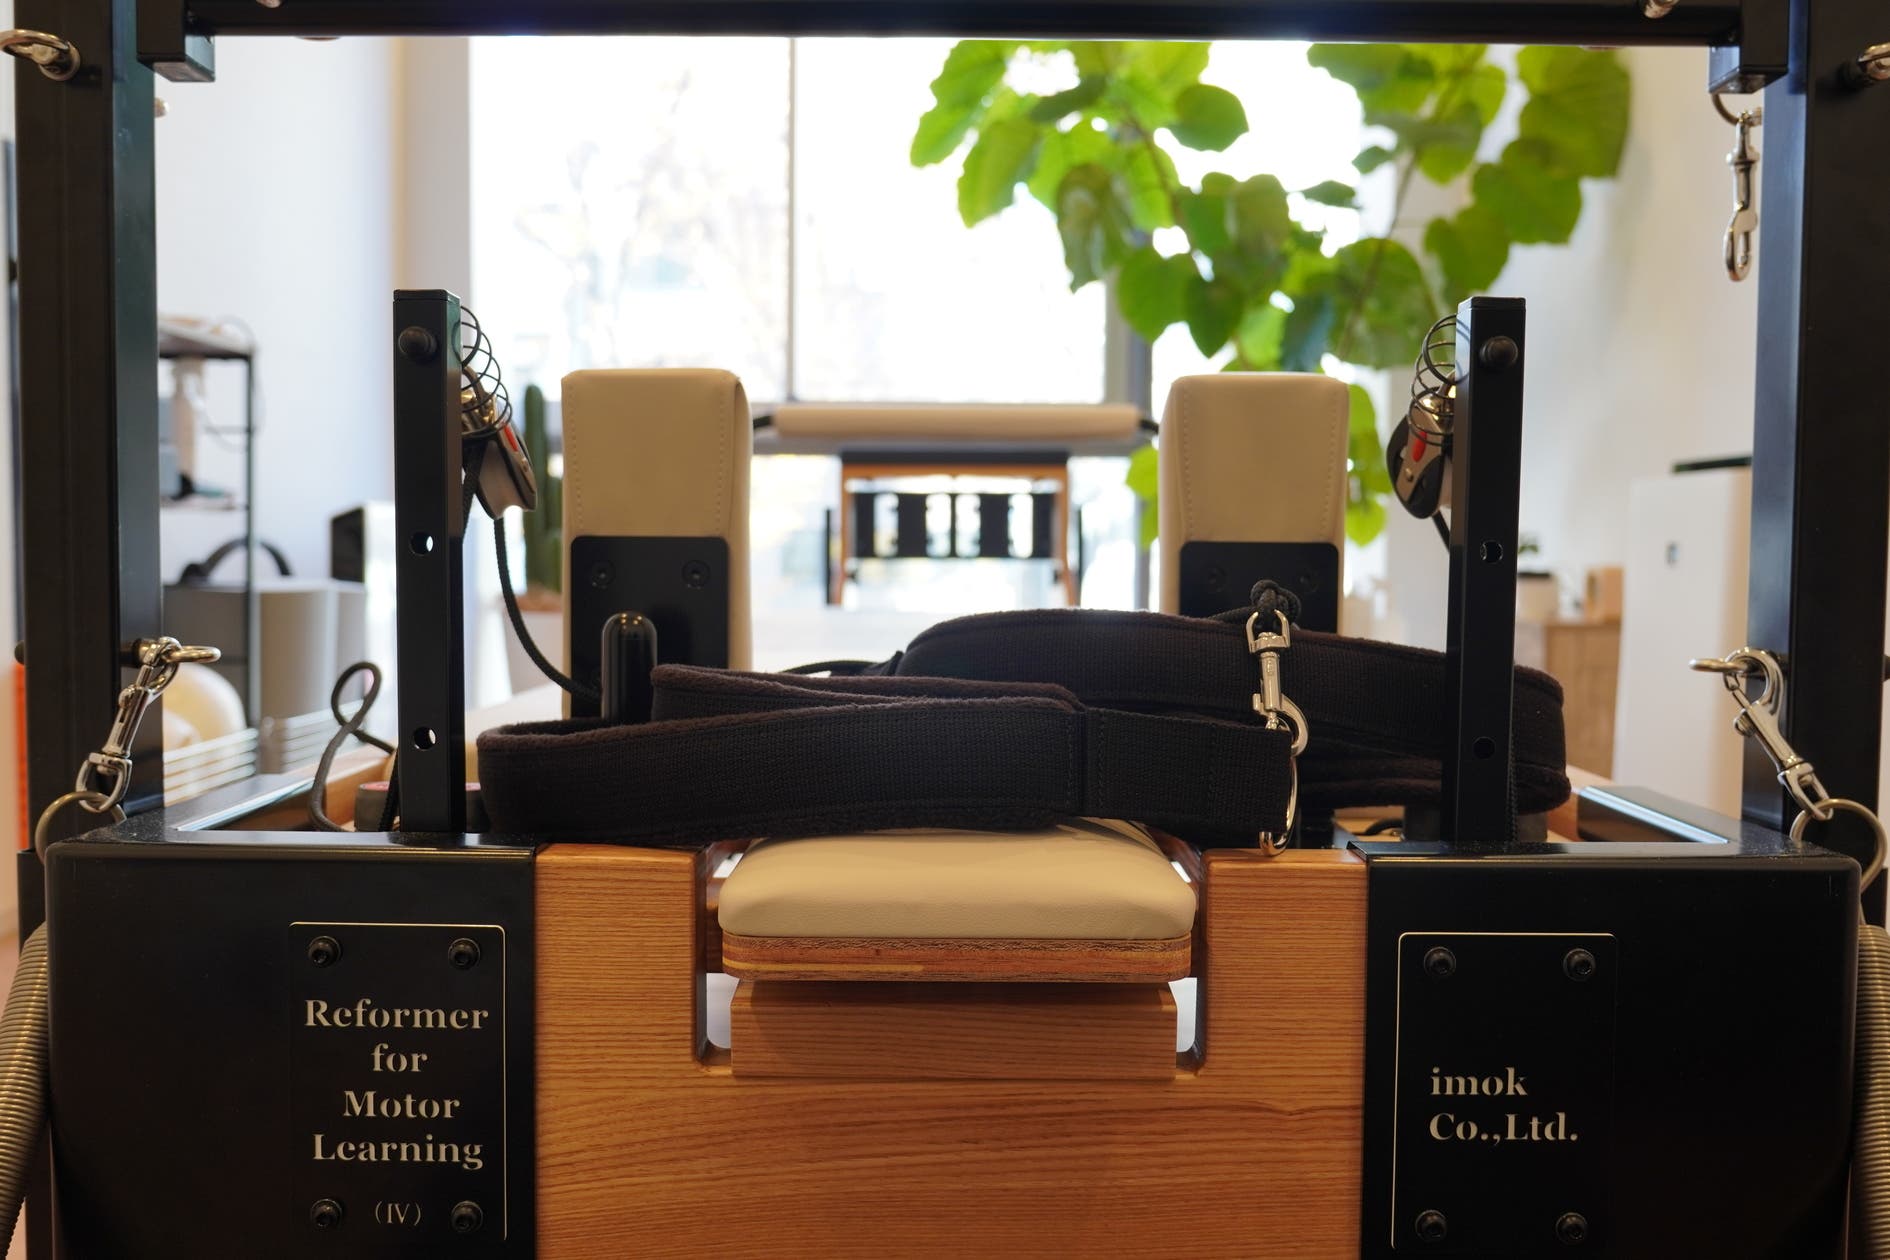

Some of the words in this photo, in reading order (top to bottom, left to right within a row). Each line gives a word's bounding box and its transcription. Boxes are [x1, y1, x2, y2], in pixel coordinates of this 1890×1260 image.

[305, 998, 489, 1030] Reformer
[371, 1043, 428, 1073] for
[1430, 1066, 1528, 1096] imok
[343, 1090, 461, 1119] Motor
[1428, 1112, 1579, 1146] Co.,Ltd.
[312, 1133, 484, 1171] Learning
[374, 1200, 423, 1227] (IV)
